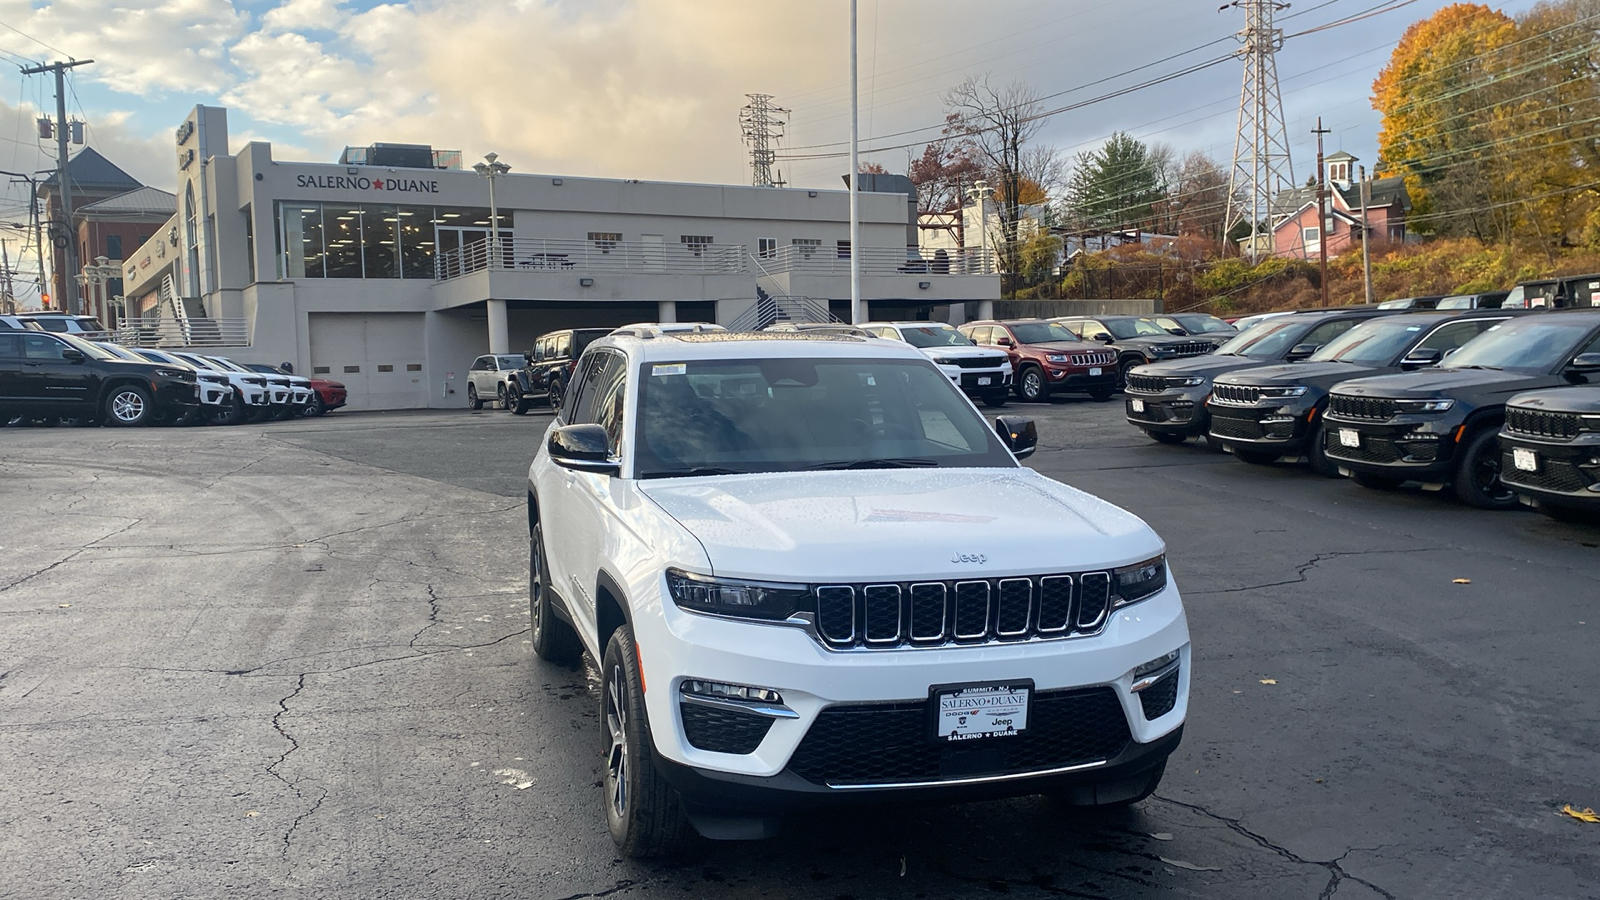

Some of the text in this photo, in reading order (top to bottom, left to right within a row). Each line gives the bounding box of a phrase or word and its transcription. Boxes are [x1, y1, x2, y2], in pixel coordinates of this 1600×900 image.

[296, 174, 440, 194] SALERNO DUANE
[949, 551, 988, 565] Jeep
[941, 695, 1026, 709] SALERNO DUANE
[991, 717, 1013, 726] Jeep
[947, 729, 1018, 742] SALERNO DUANE
